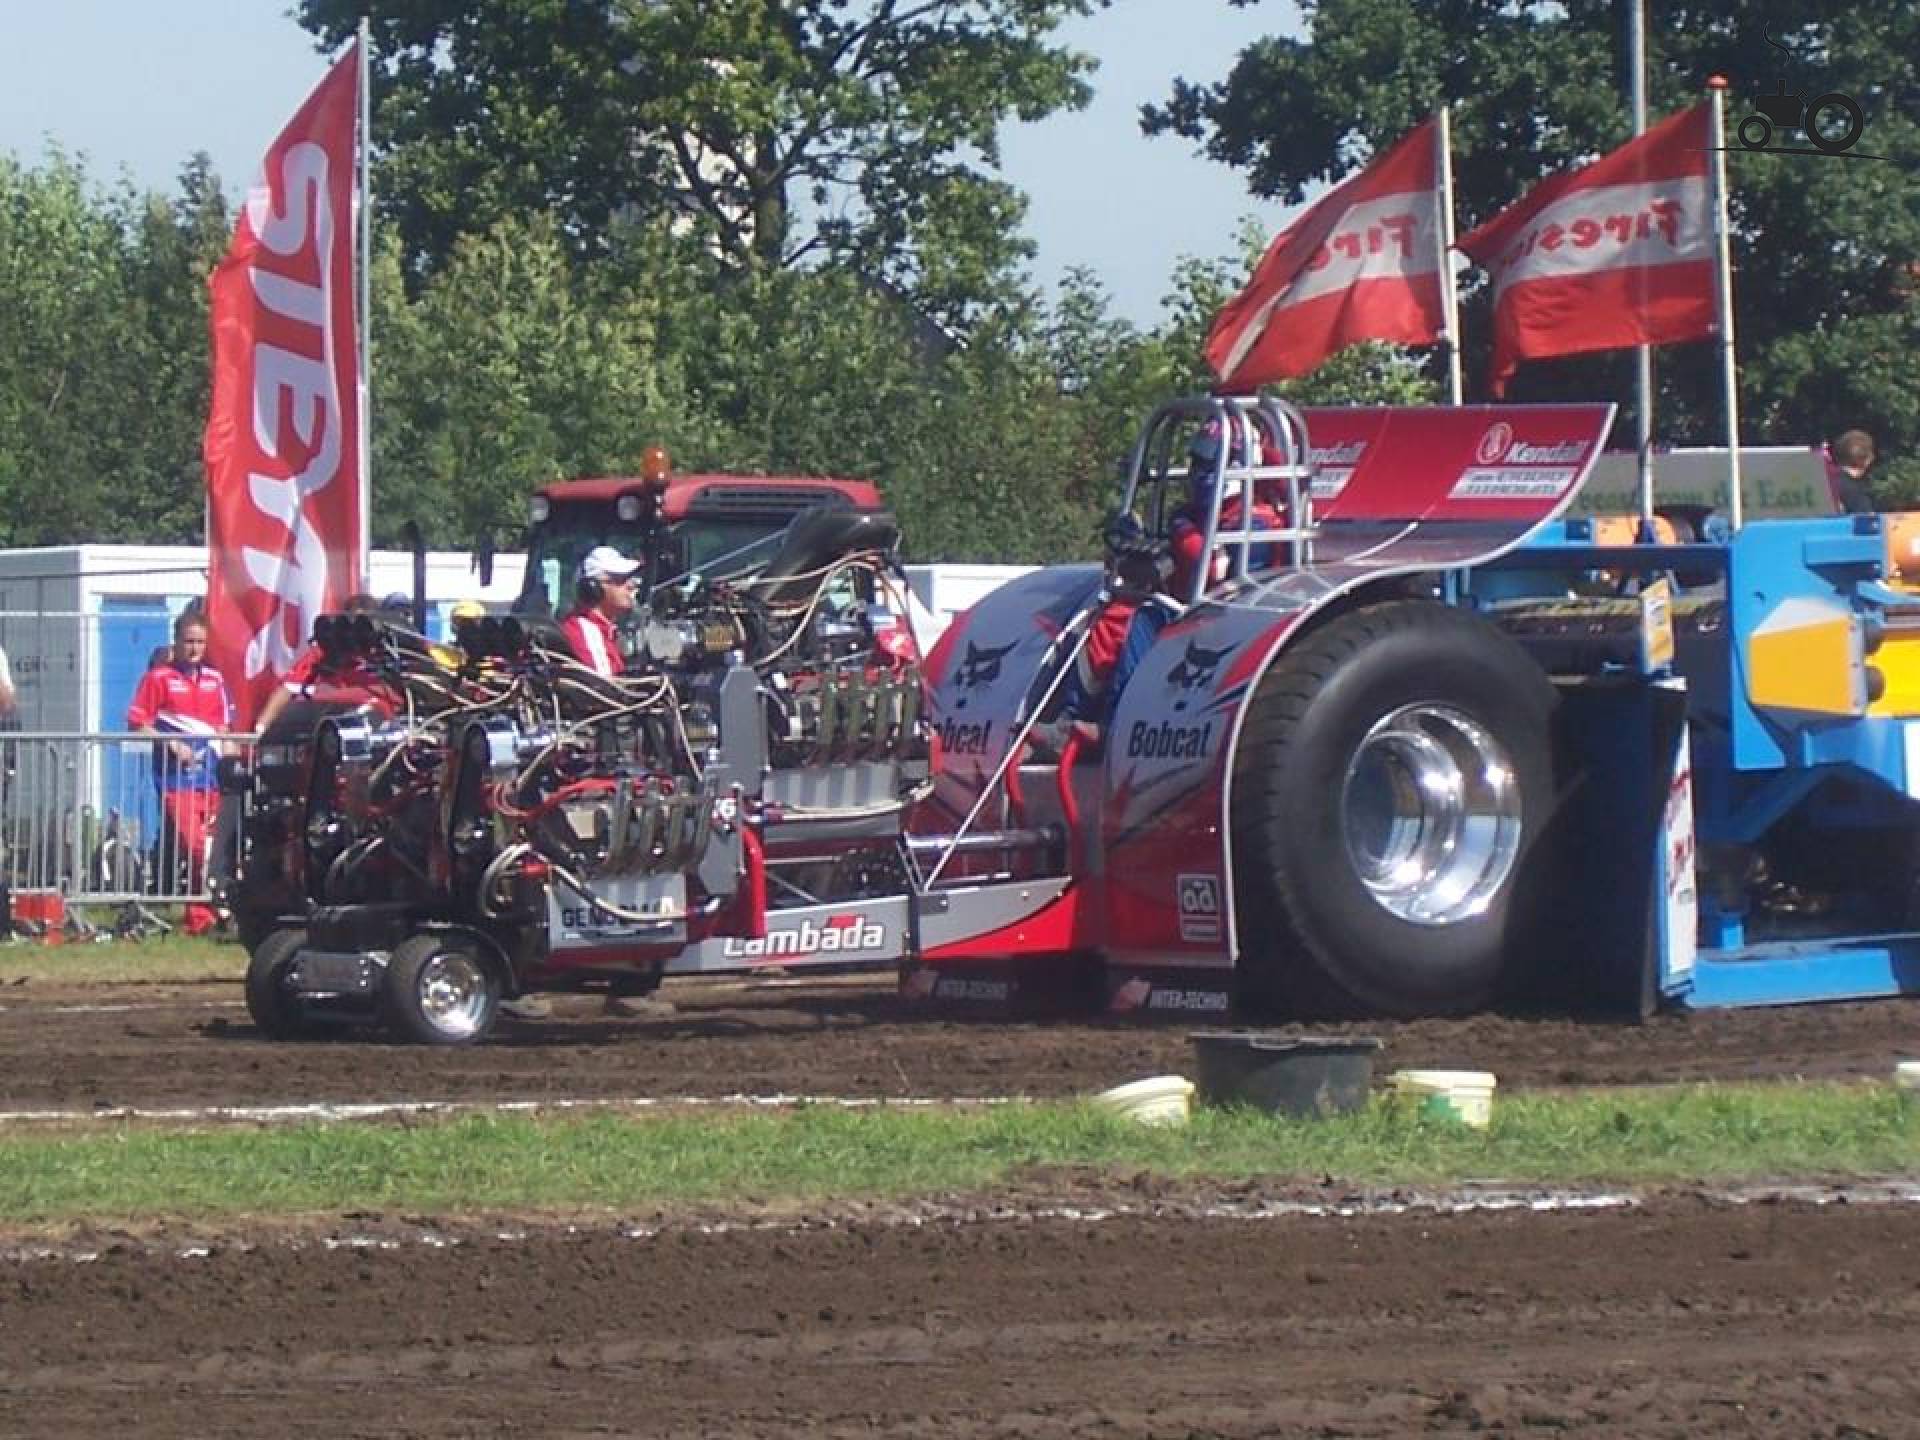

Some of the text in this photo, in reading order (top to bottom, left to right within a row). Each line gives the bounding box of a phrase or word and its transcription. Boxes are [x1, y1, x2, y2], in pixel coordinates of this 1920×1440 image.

[242, 141, 342, 680] STEYR
[1503, 439, 1592, 463] Kendall
[1127, 719, 1212, 759] Bobcat
[724, 912, 885, 957] Lambada
